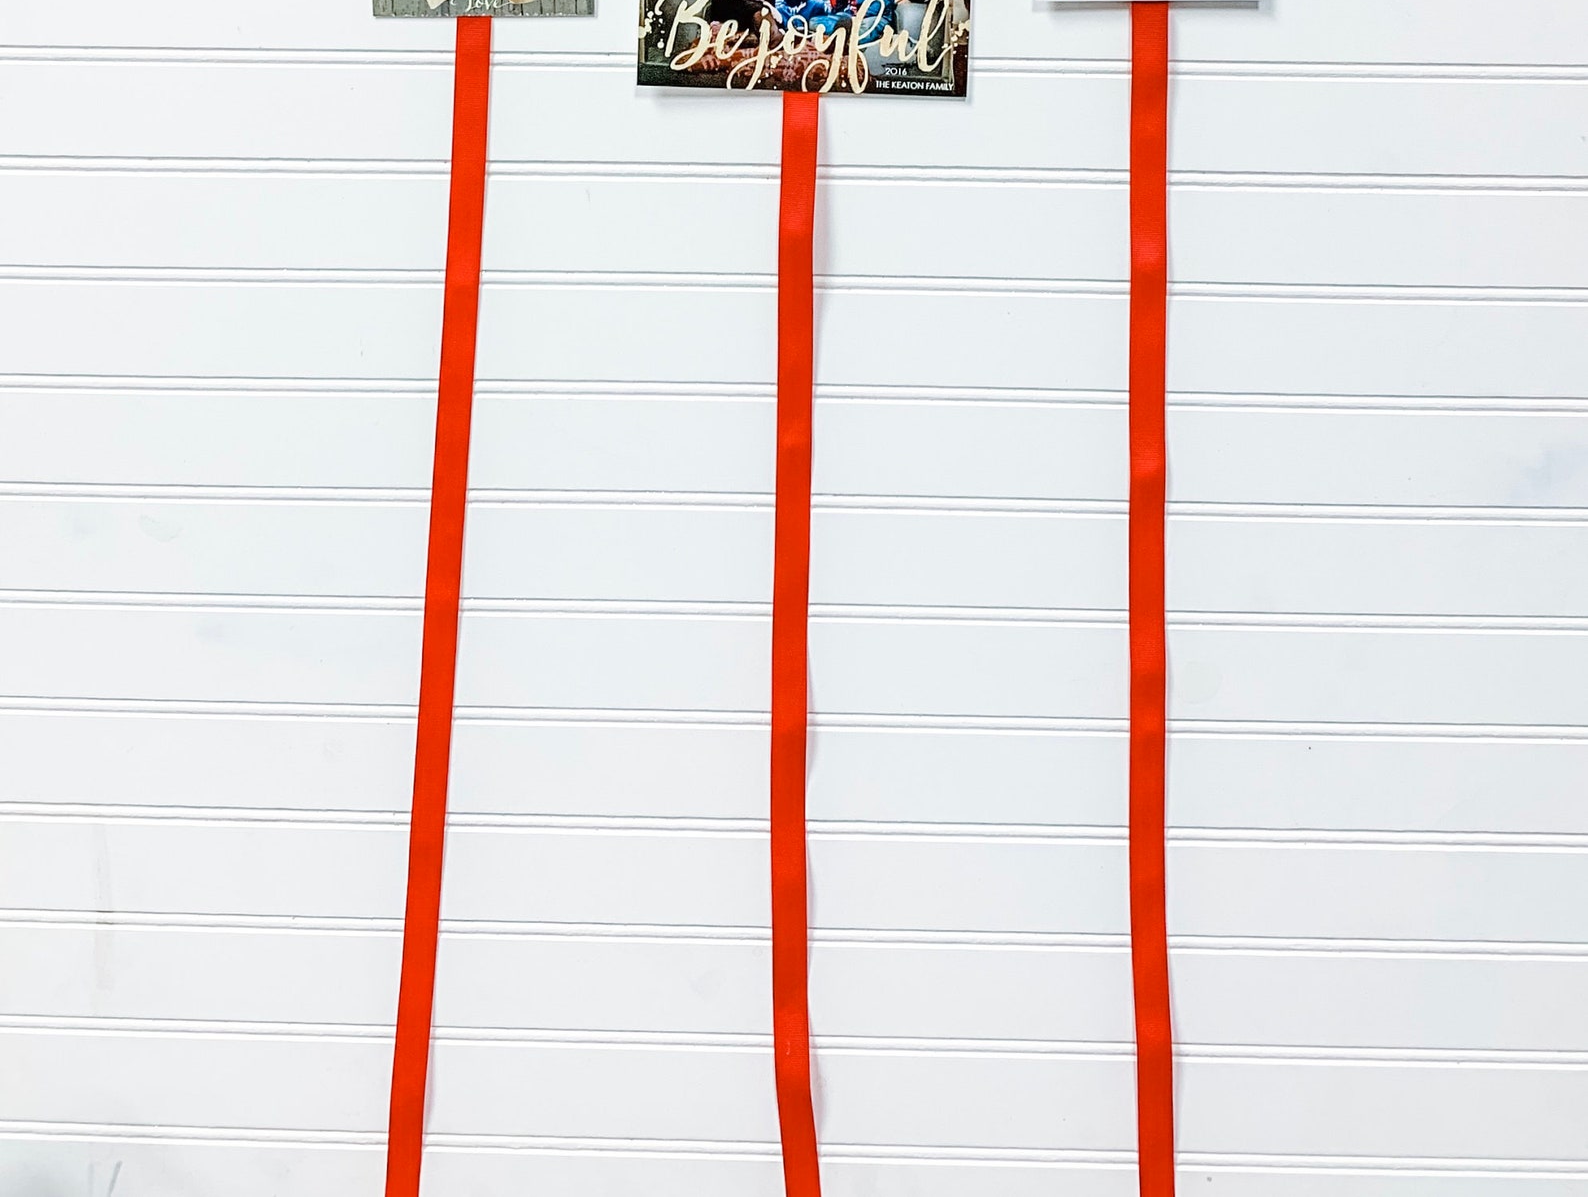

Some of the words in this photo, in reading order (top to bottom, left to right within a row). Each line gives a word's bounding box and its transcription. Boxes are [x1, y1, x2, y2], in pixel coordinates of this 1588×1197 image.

[885, 67, 908, 76] 2016
[875, 80, 890, 89] THE
[891, 81, 925, 90] KEATON
[925, 82, 954, 91] FAMILY
